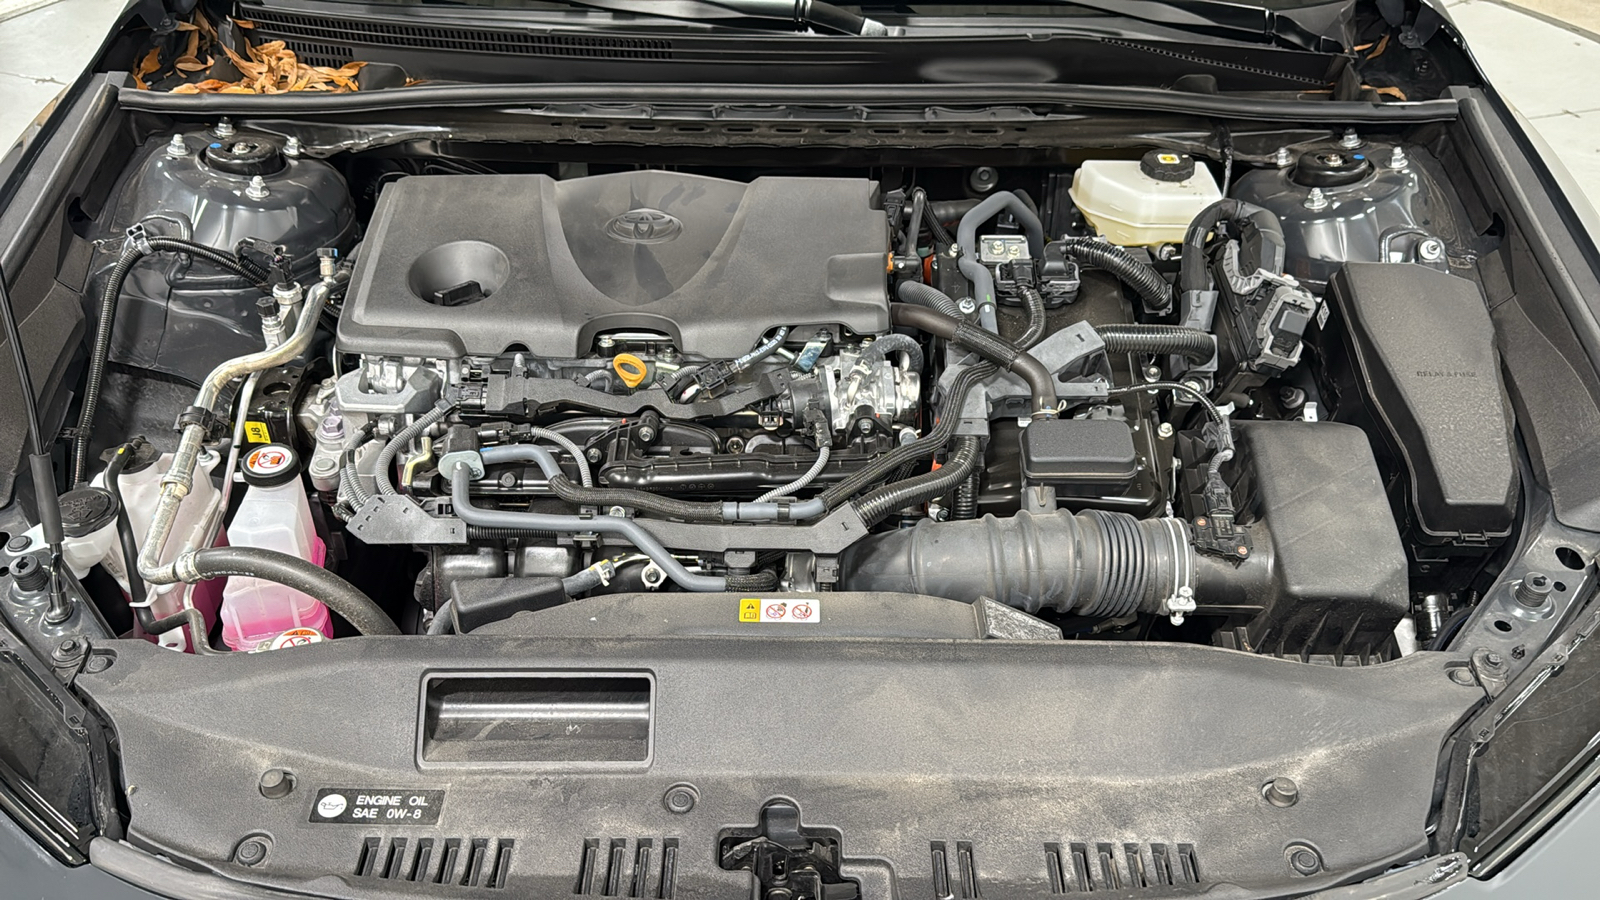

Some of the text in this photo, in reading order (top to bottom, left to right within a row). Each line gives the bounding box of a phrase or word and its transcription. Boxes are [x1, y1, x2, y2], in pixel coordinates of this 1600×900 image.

[356, 795, 429, 806] ENGINE OIL
[352, 808, 422, 819] SAE 0W-8
